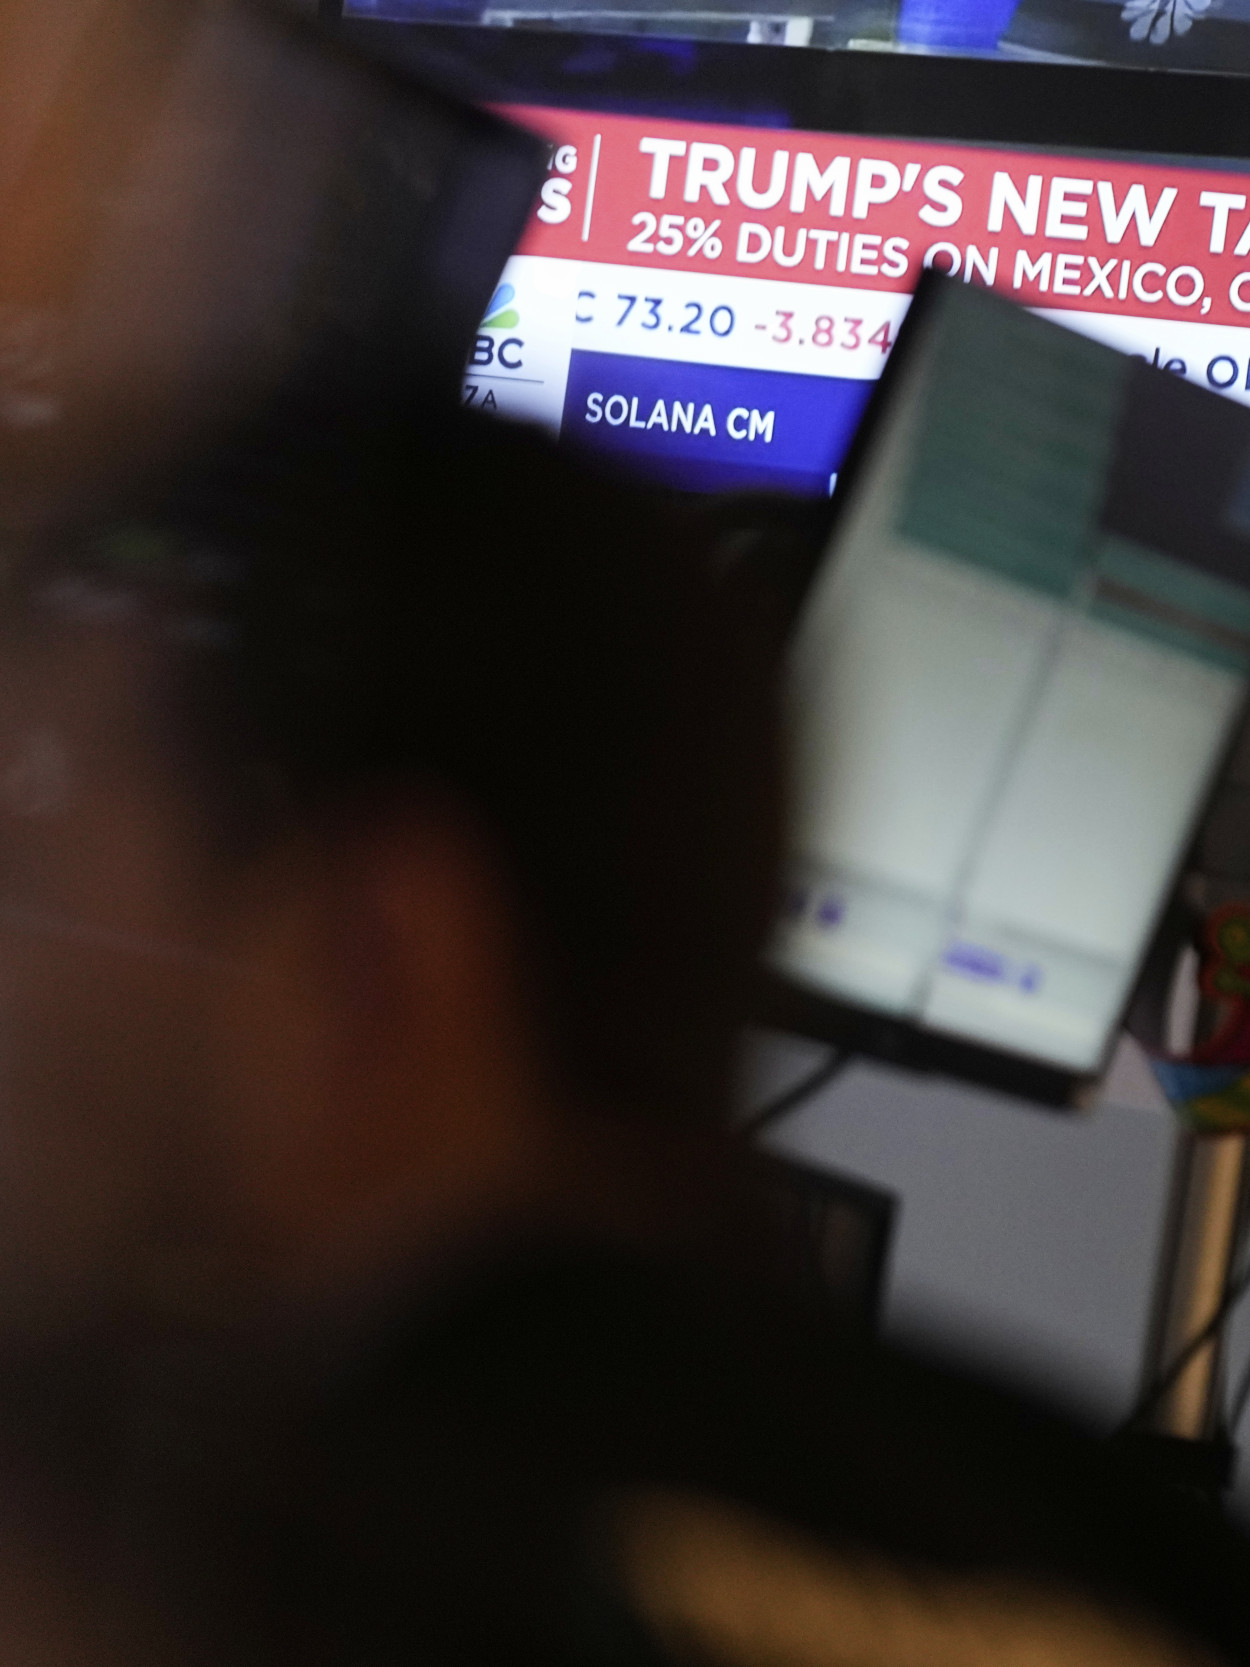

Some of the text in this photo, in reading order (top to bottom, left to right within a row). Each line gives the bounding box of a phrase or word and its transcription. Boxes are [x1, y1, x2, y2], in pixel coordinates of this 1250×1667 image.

[639, 137, 965, 227] TRUMP'S
[987, 171, 1178, 248] NEW
[627, 212, 723, 260] 25%
[736, 222, 910, 278] DUTIES
[924, 242, 999, 287] ON
[1012, 249, 1212, 316] MEXICO,
[616, 294, 735, 338] 73.20
[585, 392, 775, 444] SOLANA CM
